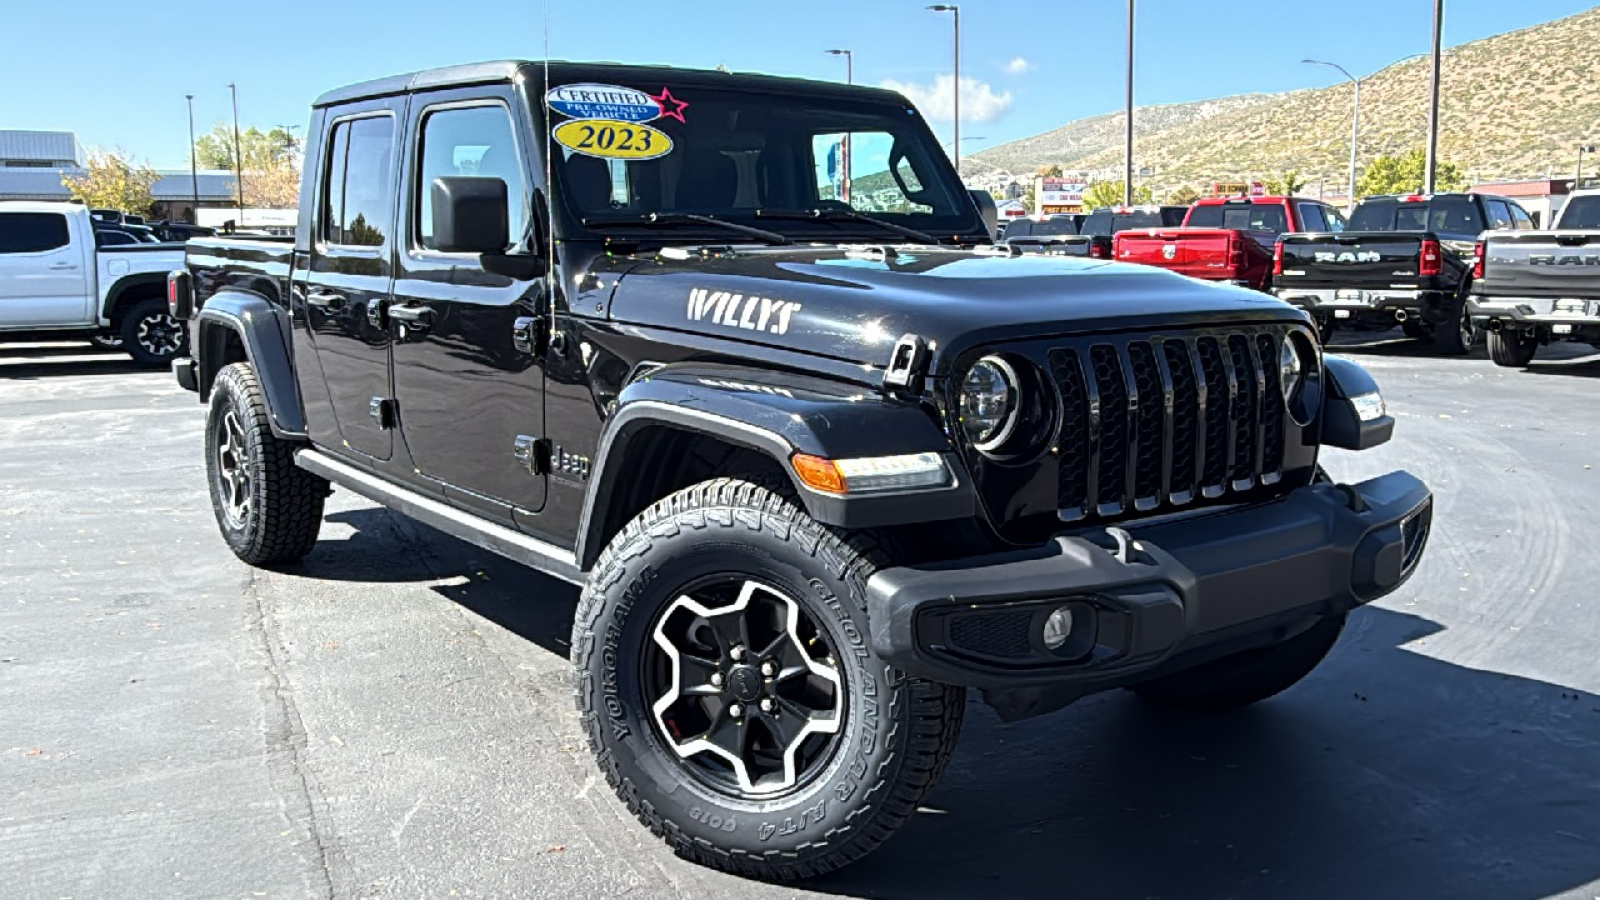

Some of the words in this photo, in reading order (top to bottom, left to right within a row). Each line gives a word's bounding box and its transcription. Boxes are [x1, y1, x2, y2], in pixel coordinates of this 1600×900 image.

[557, 89, 648, 106] CERTIFIED
[565, 102, 649, 114] PRE-OWNED
[582, 109, 641, 120] VEHICLE
[576, 125, 651, 152] 2023
[1314, 251, 1381, 263] RAM
[686, 287, 802, 336] WILLYS
[551, 445, 589, 479] Jeep
[601, 563, 659, 742] YOKOHAMA
[808, 577, 880, 802] GEOLANDAR
